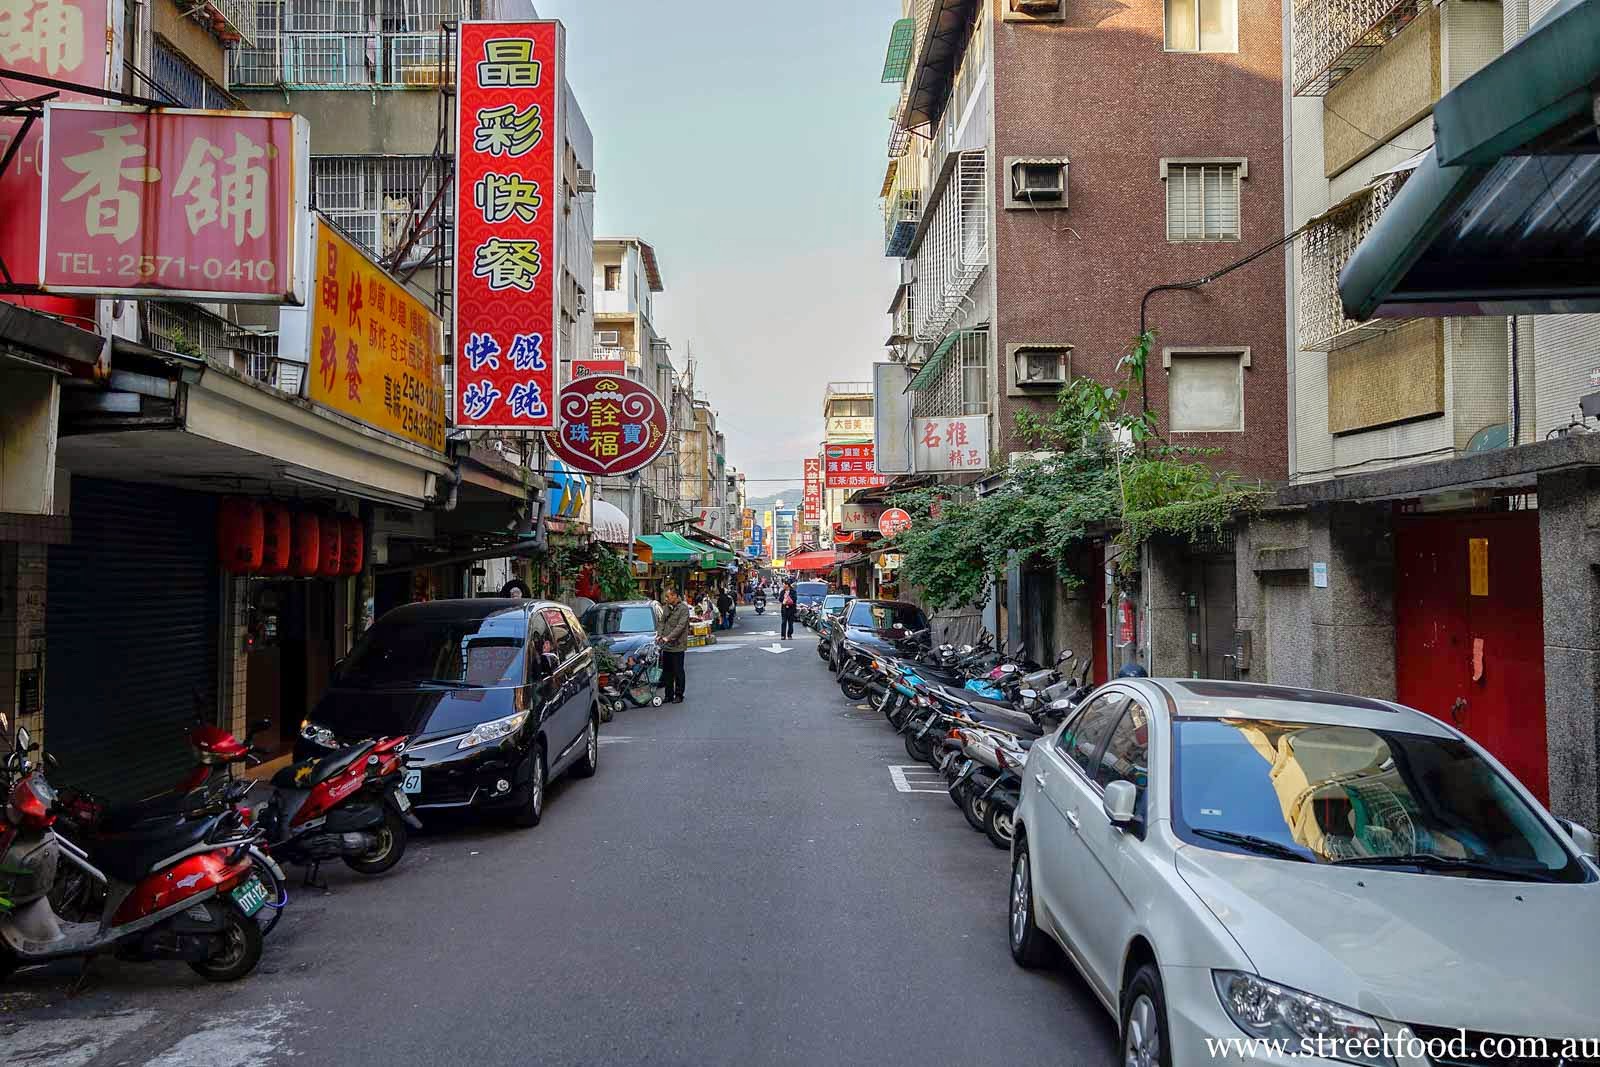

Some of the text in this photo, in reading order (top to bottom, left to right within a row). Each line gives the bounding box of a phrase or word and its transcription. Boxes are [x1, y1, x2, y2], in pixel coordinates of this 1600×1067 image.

[473, 38, 542, 293] 晶彩快餐
[319, 240, 339, 394] 晶彩
[345, 270, 363, 403] 快餐
[464, 332, 501, 419] 快炒
[506, 332, 548, 418] 餛飩
[589, 401, 621, 458] 詮福
[920, 422, 968, 448] 名雅
[949, 450, 981, 466] 精品
